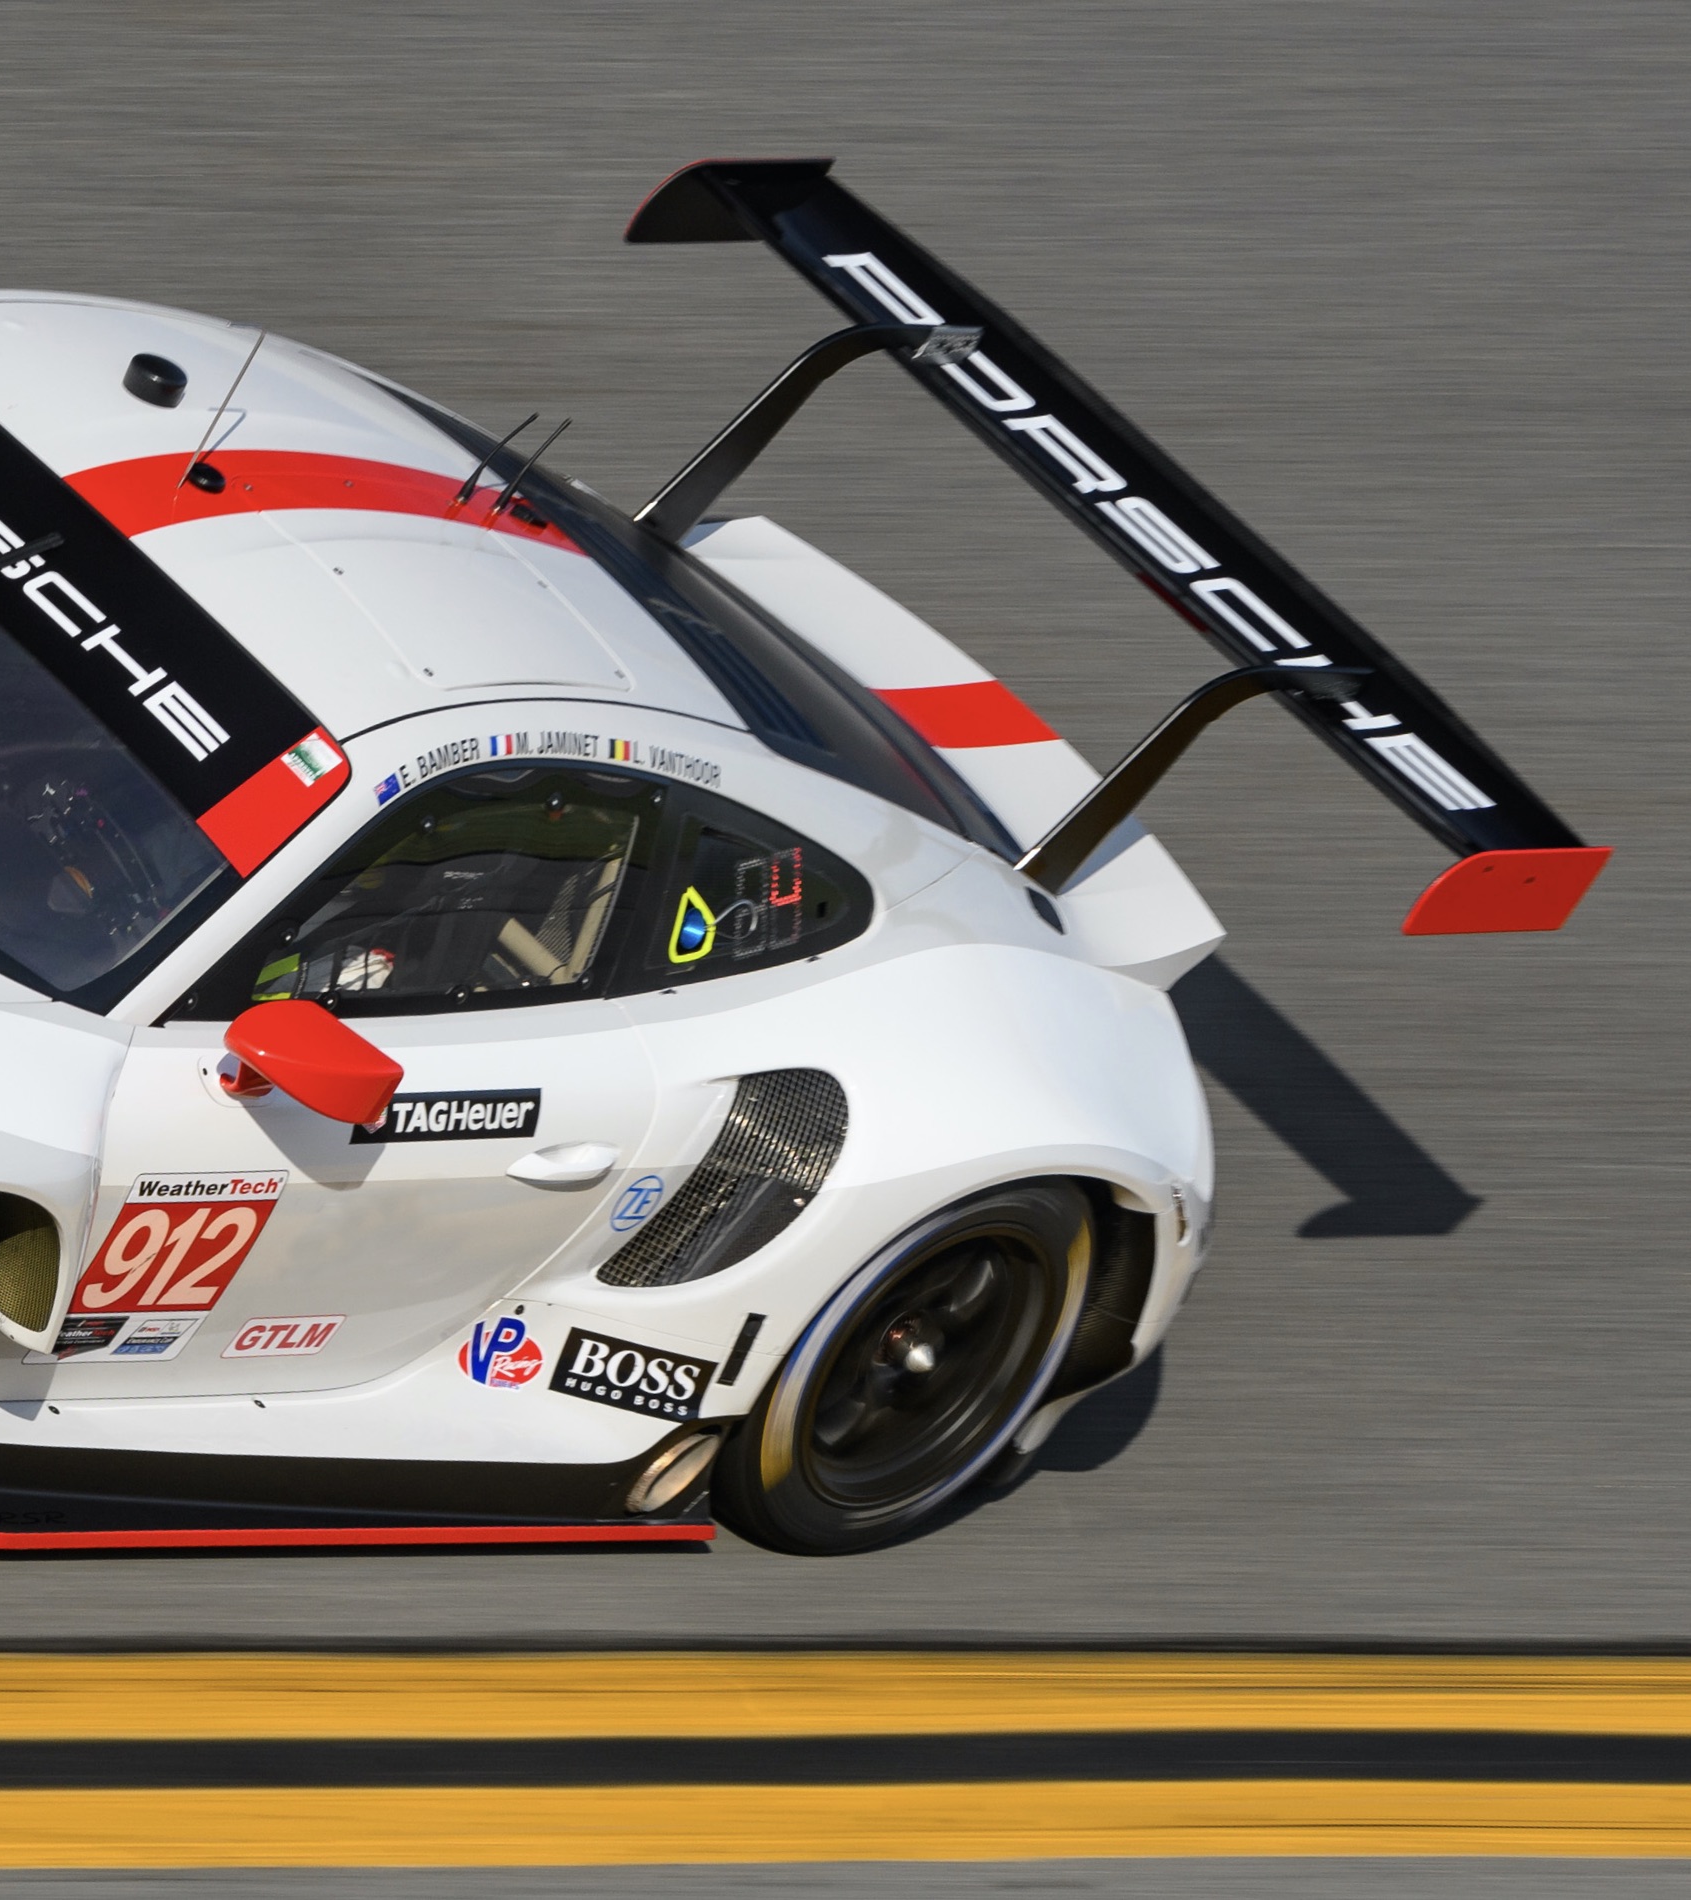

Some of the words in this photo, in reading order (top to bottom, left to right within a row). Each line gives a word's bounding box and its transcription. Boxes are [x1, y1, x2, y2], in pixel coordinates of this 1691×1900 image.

[419, 738, 481, 779] BAMBER
[516, 731, 533, 756] M.
[537, 731, 600, 758] JAMINET
[648, 746, 722, 789] VANTHOOR
[615, 1187, 663, 1221] ZF
[81, 1206, 258, 1309] 912
[234, 1322, 338, 1351] GTLM
[469, 1316, 527, 1386] VP
[568, 1338, 702, 1401] BOSS
[565, 1377, 622, 1400] HUGO
[633, 1395, 689, 1416] BOSS
